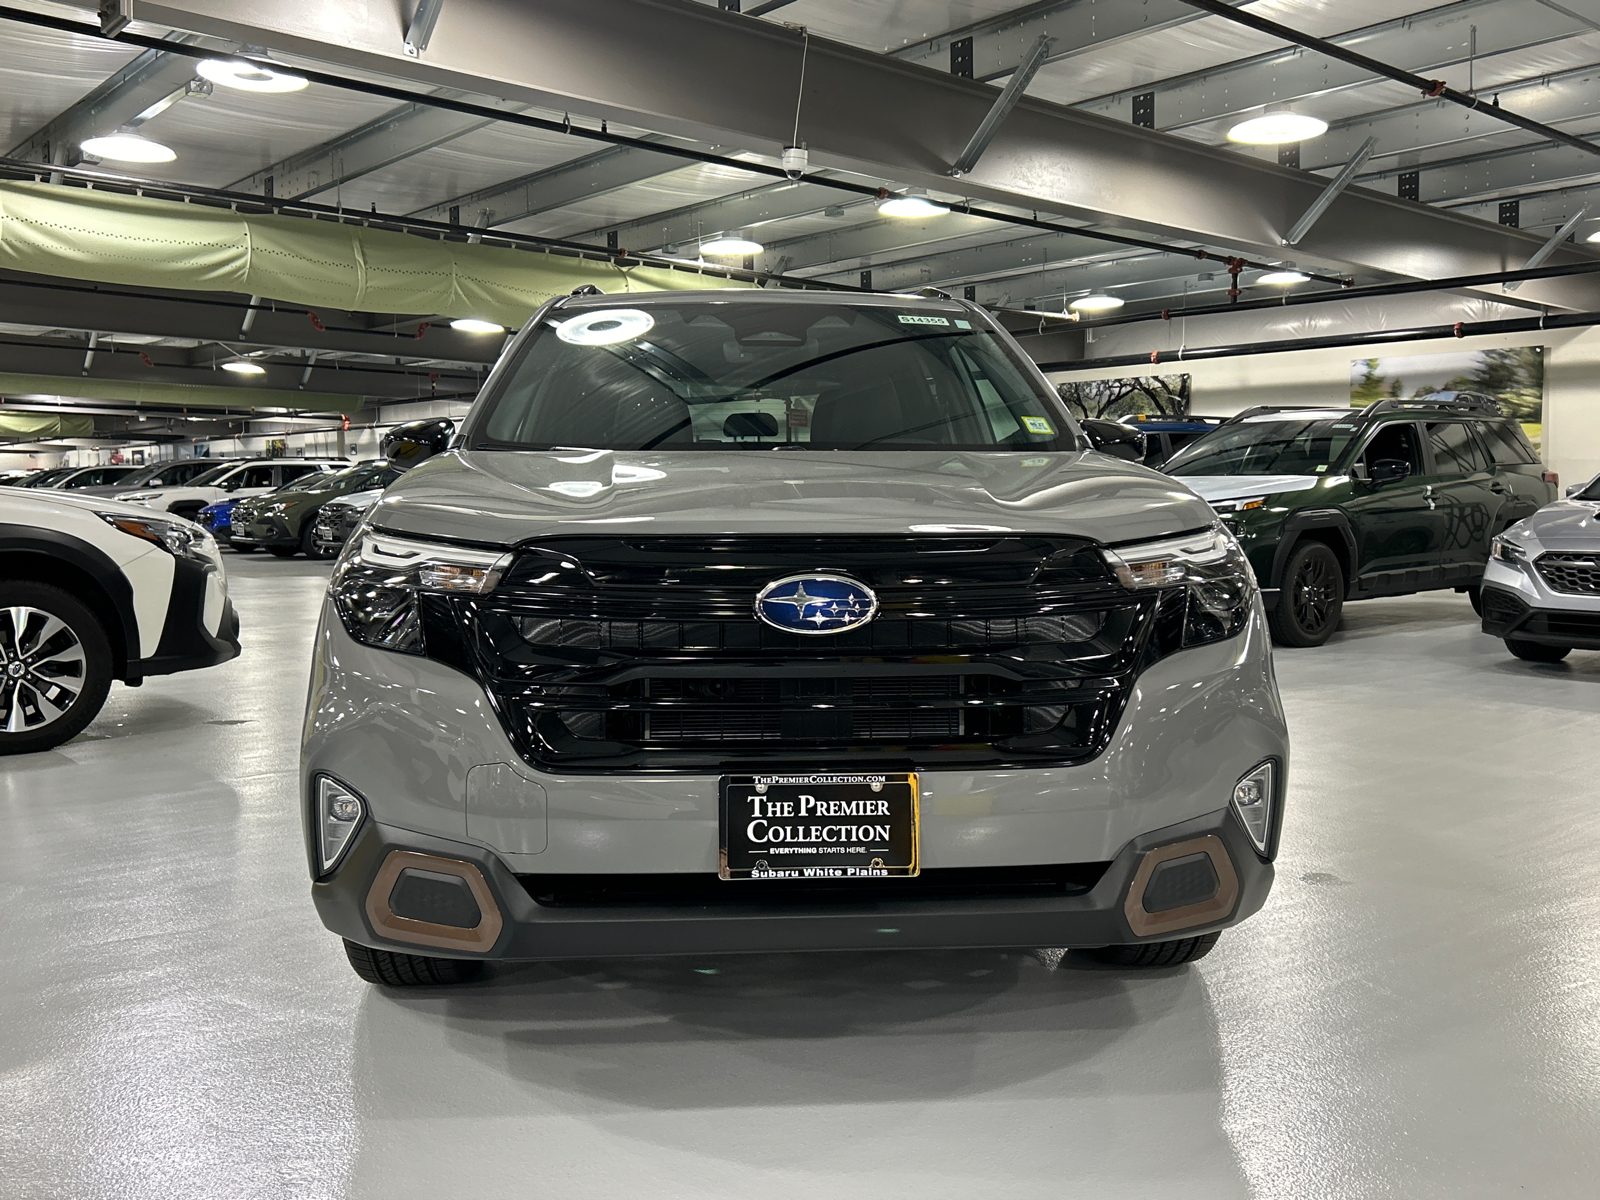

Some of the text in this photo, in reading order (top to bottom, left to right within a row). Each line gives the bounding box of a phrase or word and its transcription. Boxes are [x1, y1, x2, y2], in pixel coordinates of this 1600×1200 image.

[769, 847, 817, 855] EVERYTHING
[751, 868, 889, 878] Subaru White Plains
